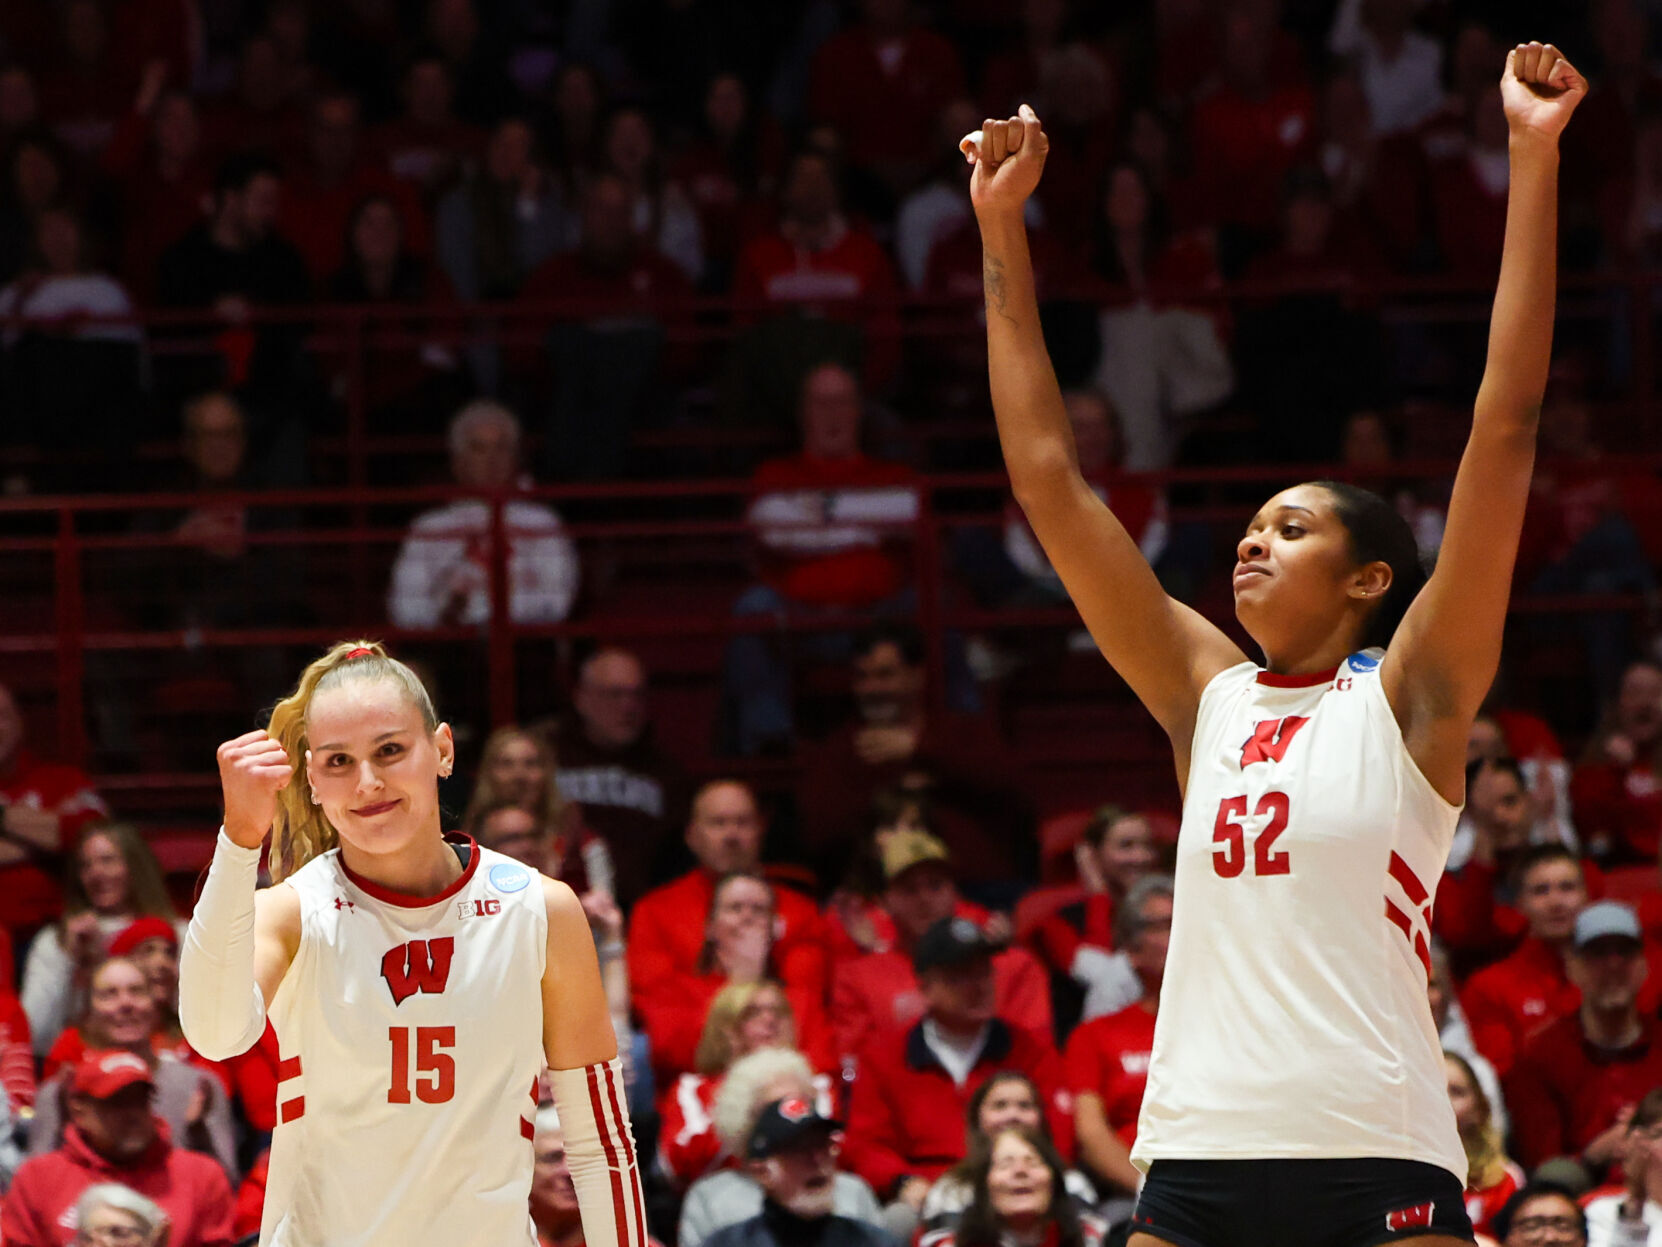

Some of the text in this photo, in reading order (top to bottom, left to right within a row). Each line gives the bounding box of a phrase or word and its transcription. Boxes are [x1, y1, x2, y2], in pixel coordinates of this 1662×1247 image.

[1212, 791, 1290, 879] 52
[458, 899, 501, 920] BIG
[381, 936, 454, 1008] W
[388, 1026, 455, 1104] 15
